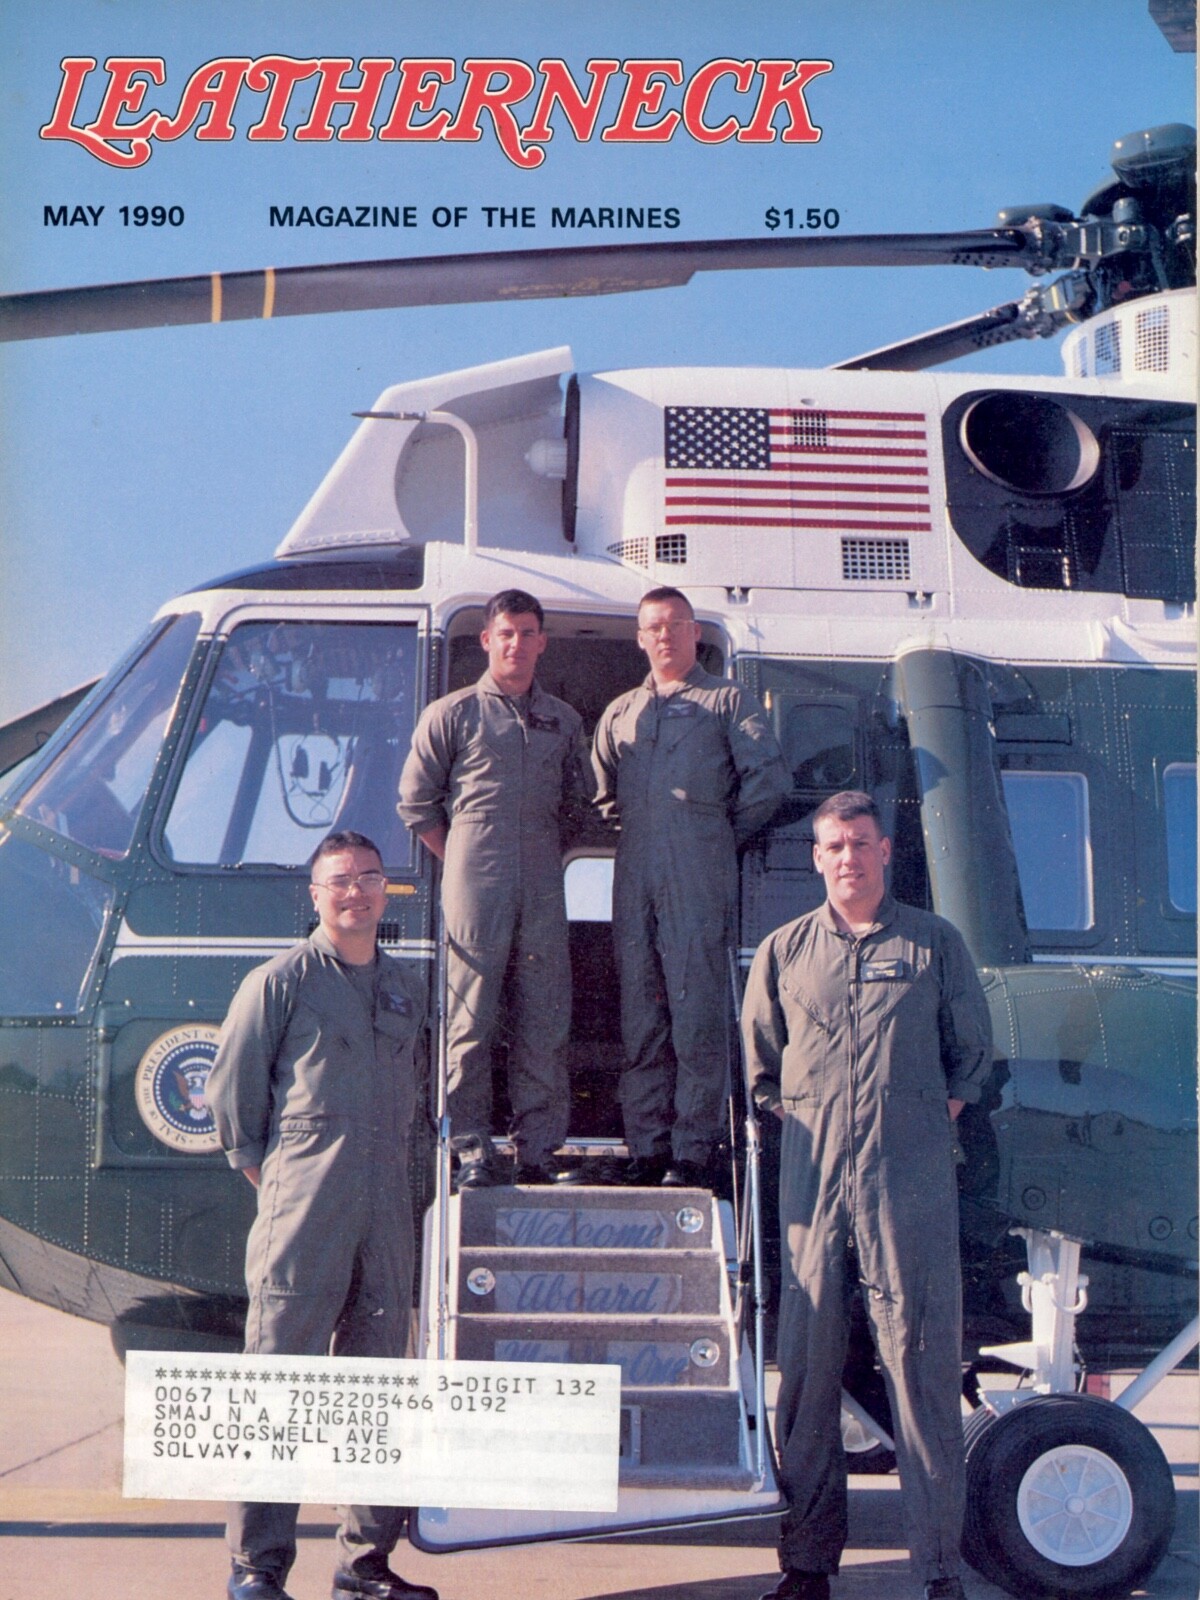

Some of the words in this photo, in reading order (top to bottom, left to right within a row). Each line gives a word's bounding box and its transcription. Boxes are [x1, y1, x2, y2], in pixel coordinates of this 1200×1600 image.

[38, 54, 834, 169] LEATHERNECK
[43, 205, 105, 227] MAY
[118, 205, 185, 227] 1990
[269, 206, 418, 228] MAGAZINE
[431, 206, 468, 228] OF
[481, 207, 536, 228] THE
[551, 207, 681, 229] MARINES
[764, 207, 840, 231] $1.50
[142, 1029, 200, 1081] PRESIDENT
[503, 1209, 666, 1248] Welcome
[513, 1272, 661, 1313] Aboard
[437, 1375, 537, 1394] 3-DIGIT
[555, 1379, 596, 1396] 132
[155, 1386, 212, 1403] 0067
[229, 1388, 257, 1405] LN
[289, 1389, 433, 1410] 7052205466
[451, 1395, 507, 1412] 0192
[155, 1404, 211, 1421] SMAJ
[228, 1407, 241, 1423] N
[258, 1407, 270, 1423] A
[288, 1408, 389, 1426] ZINGARO
[154, 1422, 196, 1439] 600
[213, 1423, 329, 1443] COGSWELL
[346, 1428, 388, 1445] AVE
[154, 1440, 252, 1459] SOLVAY,
[272, 1444, 298, 1461] NY
[332, 1447, 401, 1464] 13209
